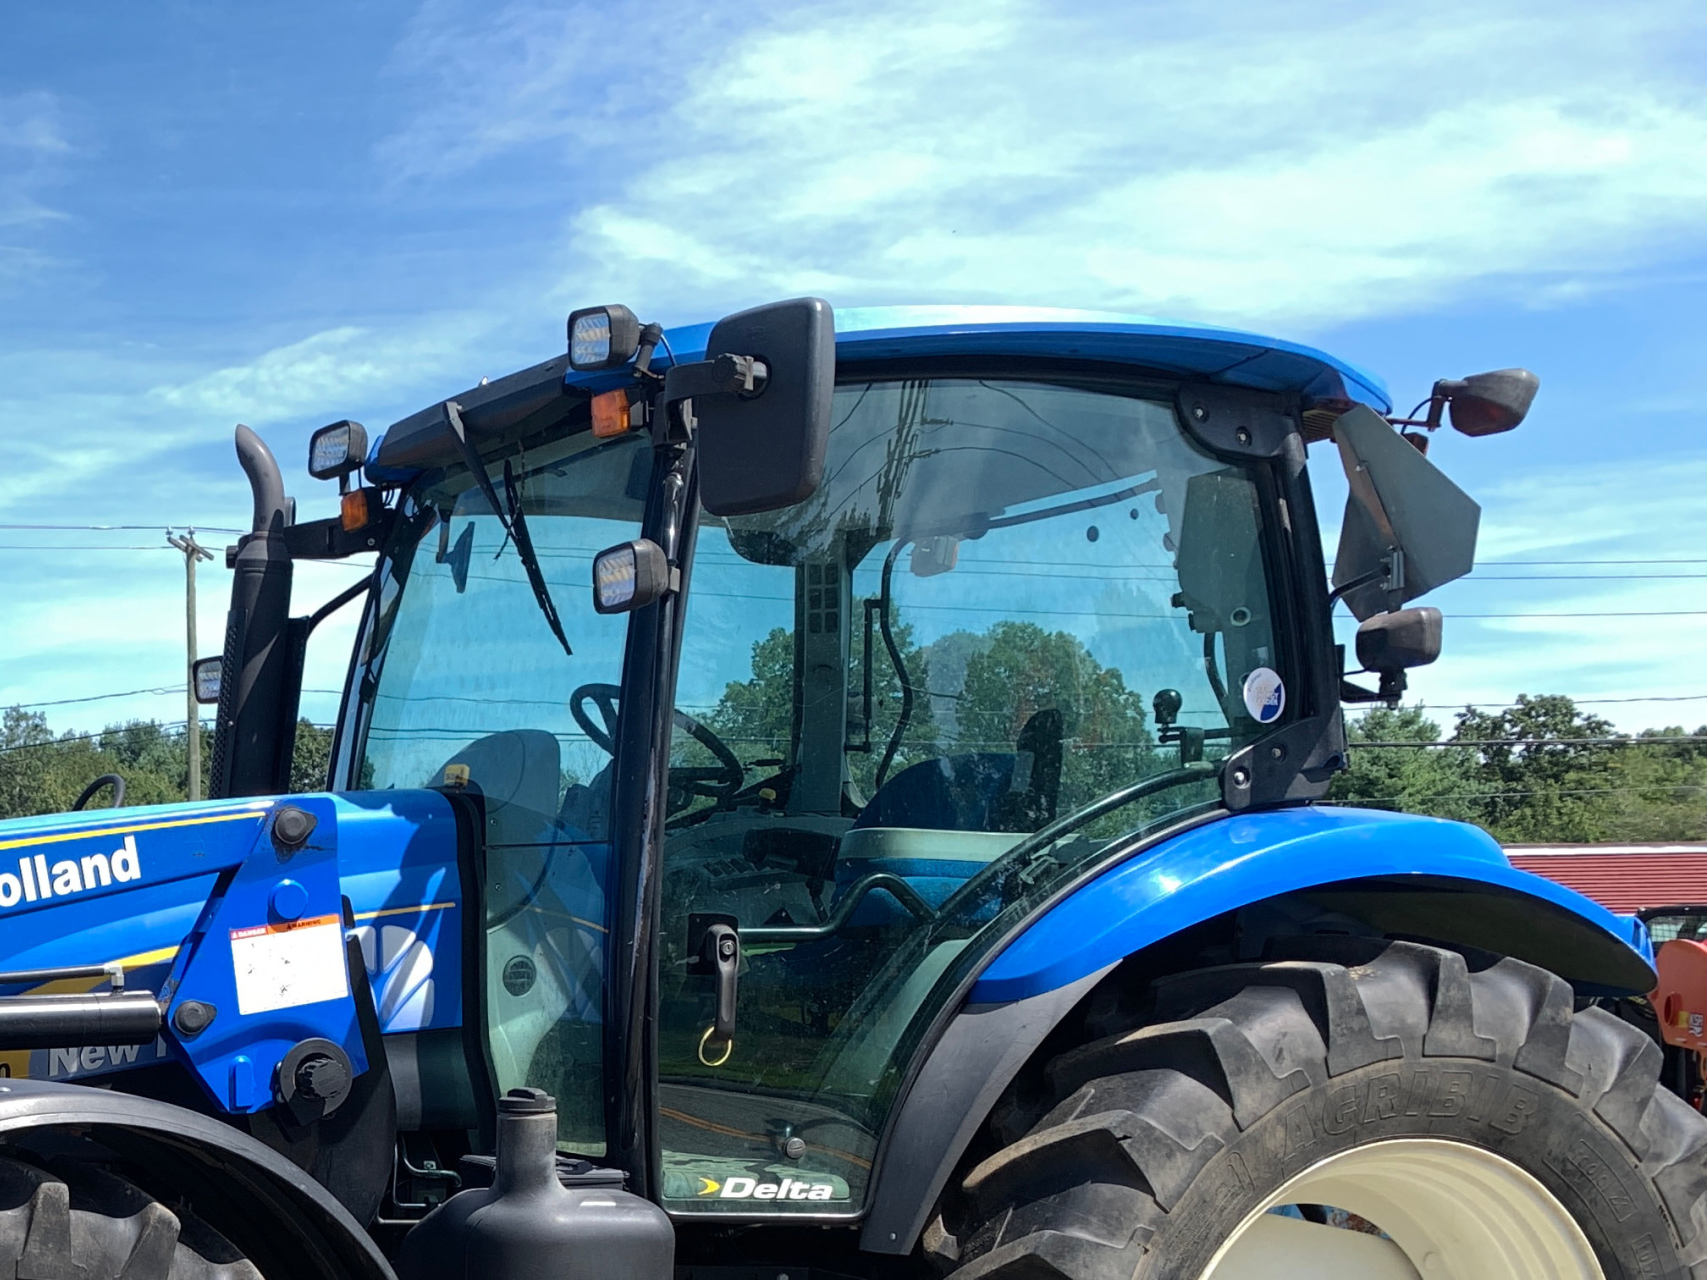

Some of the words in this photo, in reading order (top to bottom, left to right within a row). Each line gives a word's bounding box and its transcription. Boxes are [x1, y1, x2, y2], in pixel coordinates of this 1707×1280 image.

[237, 928, 266, 938] DANGER
[291, 919, 321, 928] WARNING
[49, 1045, 141, 1077] New
[1282, 1069, 1540, 1162] AGRIBIB
[720, 1177, 833, 1200] Delta
